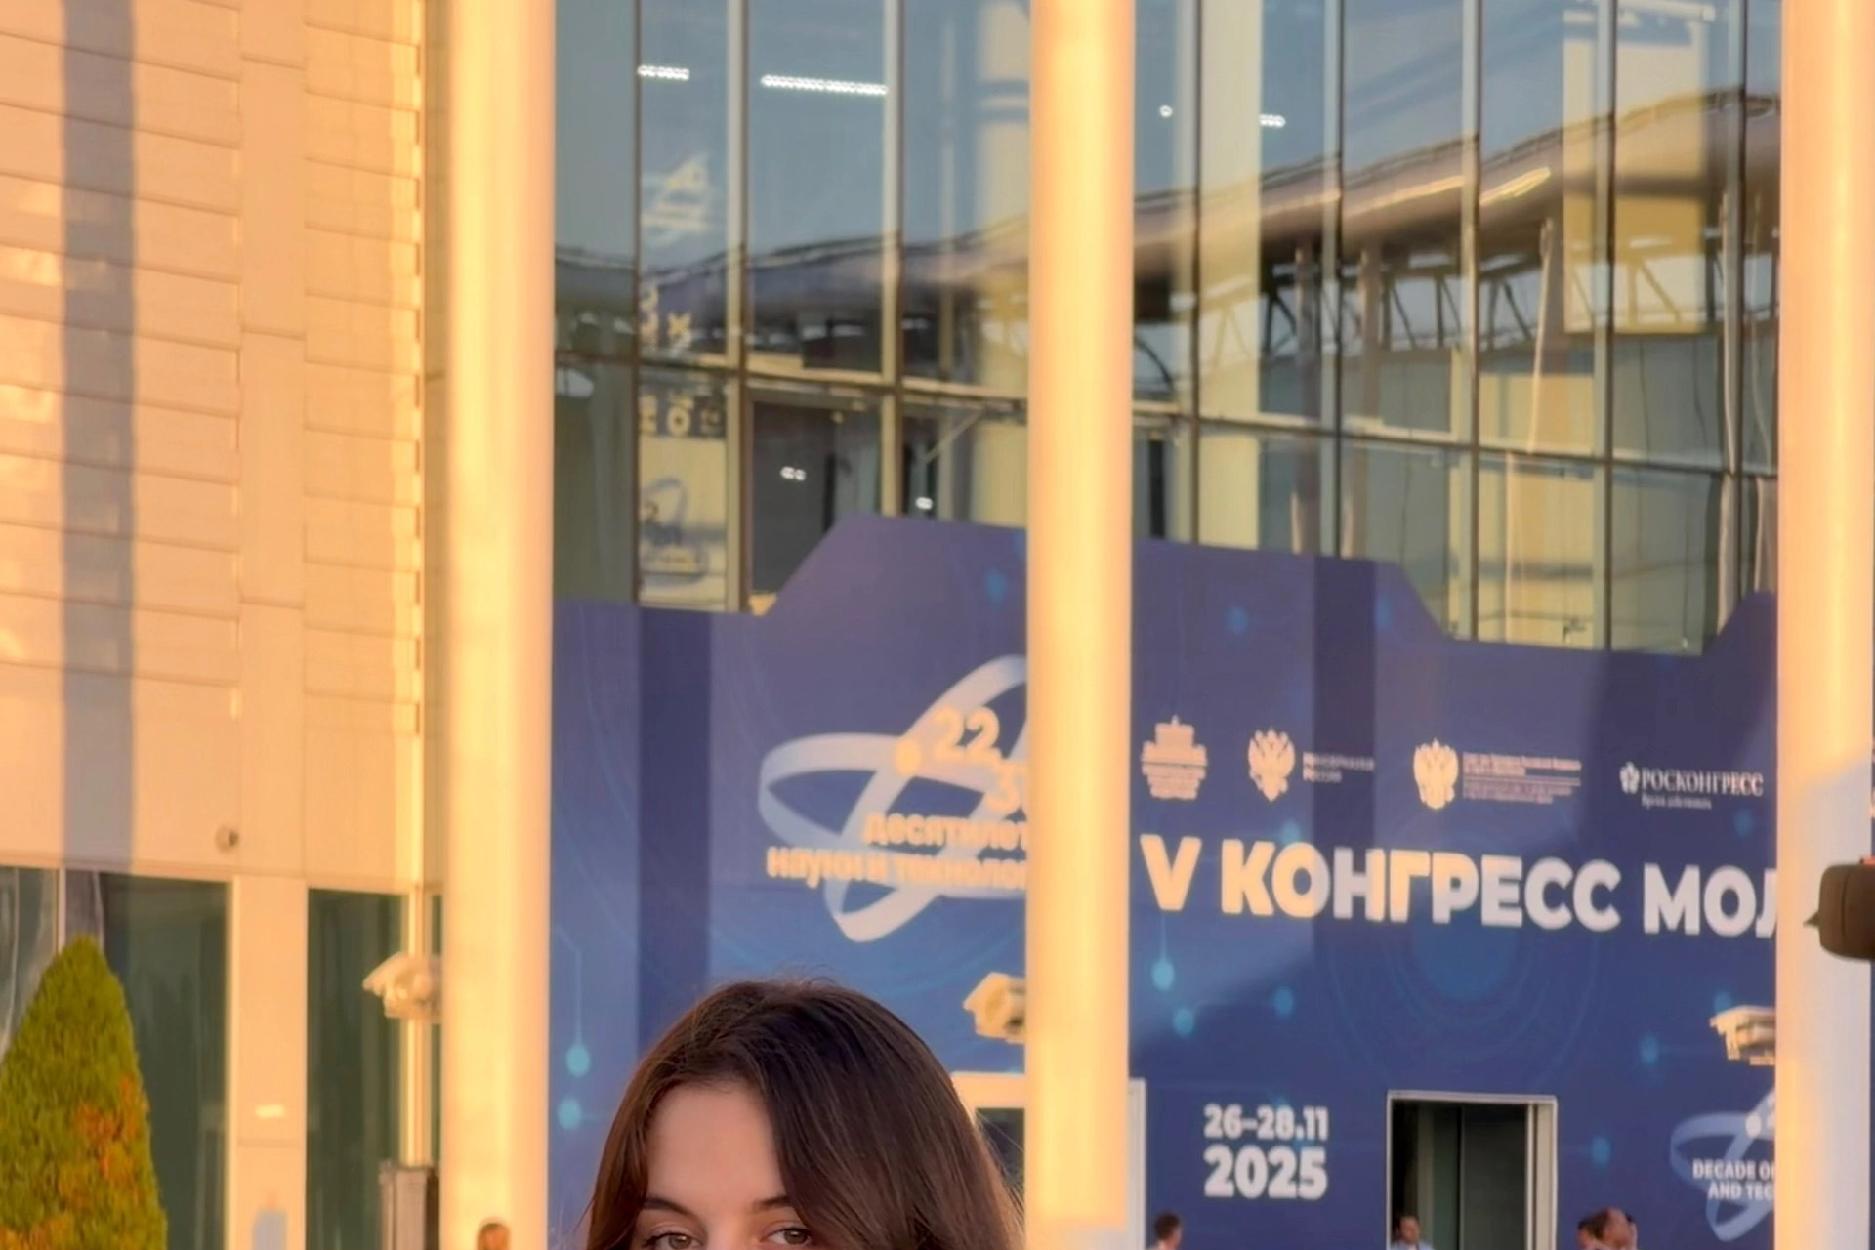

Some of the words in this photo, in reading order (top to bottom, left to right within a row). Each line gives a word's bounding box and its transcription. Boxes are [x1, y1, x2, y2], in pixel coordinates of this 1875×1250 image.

[1642, 768, 1765, 797] РОСКОНГРЕСС
[1139, 833, 1202, 911] V
[1221, 839, 1621, 932] КОНГРЕСС
[1203, 1144, 1328, 1200] 2025
[1692, 1157, 1756, 1181] DECADE
[1758, 1160, 1774, 1183] O
[1708, 1180, 1743, 1200] AND
